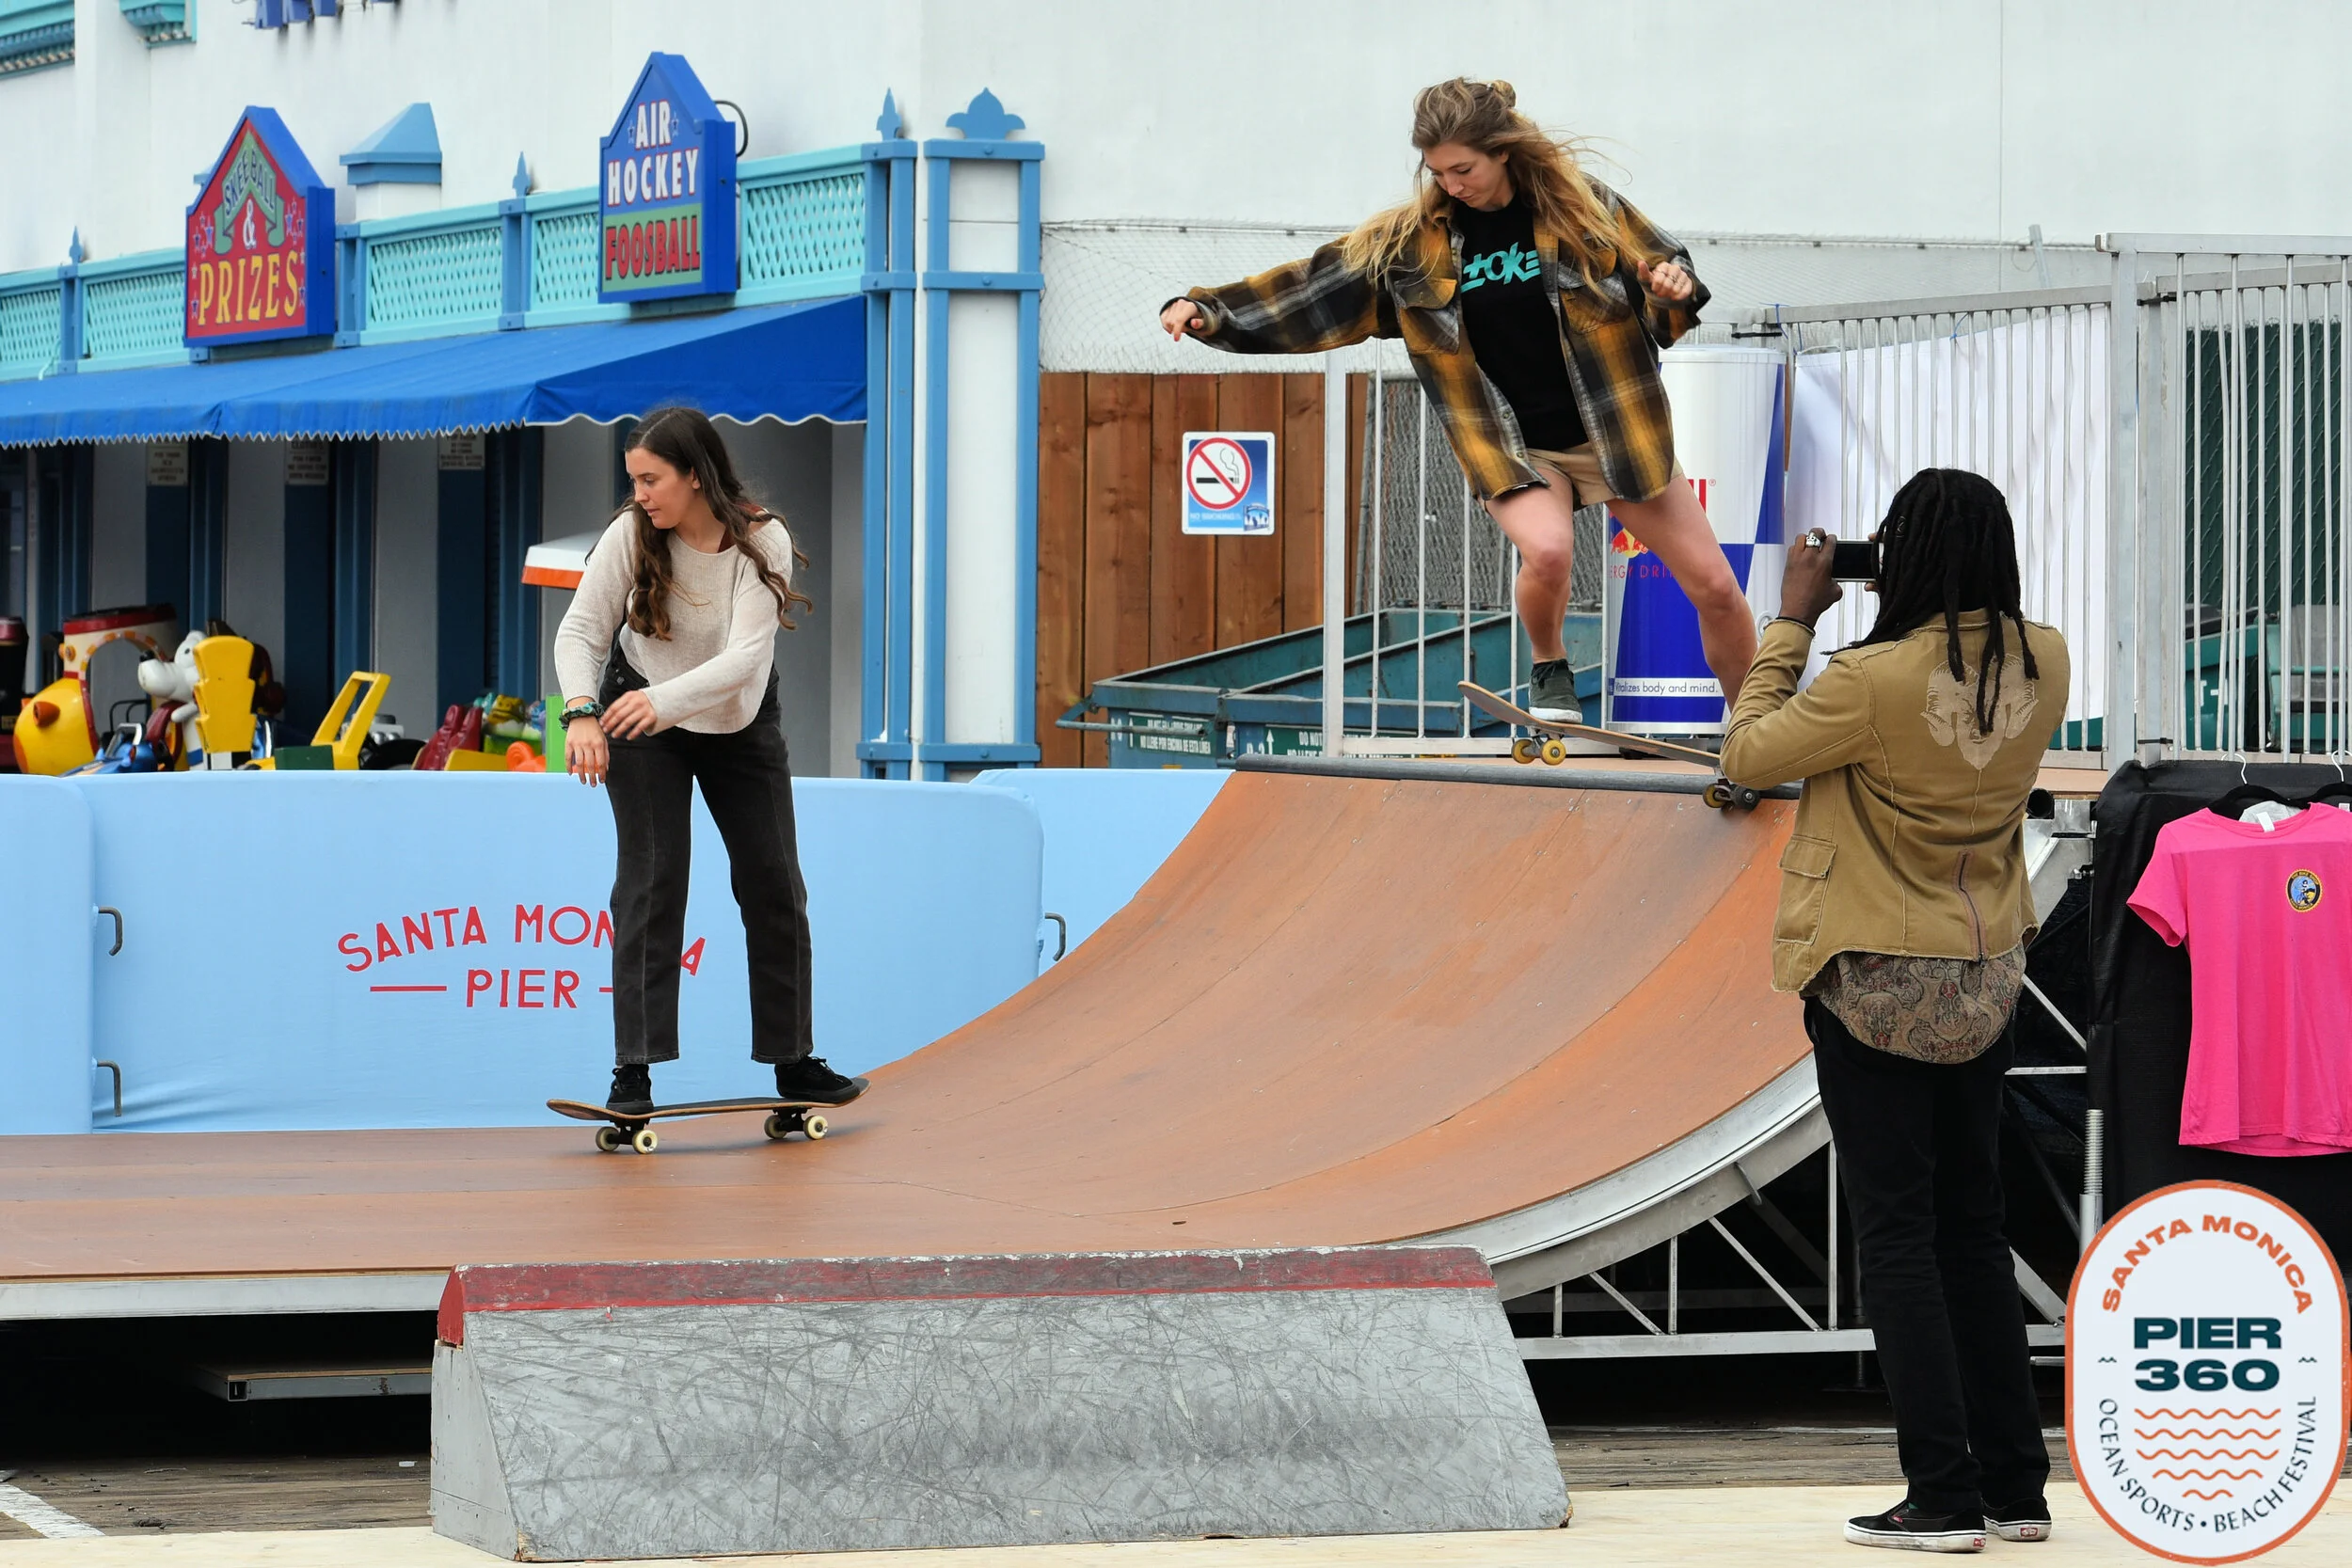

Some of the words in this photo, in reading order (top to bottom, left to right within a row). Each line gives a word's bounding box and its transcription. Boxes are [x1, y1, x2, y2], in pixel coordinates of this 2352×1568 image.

[634, 100, 672, 150] AIR
[225, 149, 250, 216] SKEE
[250, 148, 276, 211] BALL
[607, 147, 699, 207] HOCKEY
[242, 198, 257, 250] &
[605, 215, 700, 280] FOOSBALL
[198, 249, 299, 326] PRIZES
[1640, 564, 1674, 578] DRI
[1642, 681, 1665, 695] body
[1668, 682, 1687, 693] and
[1690, 682, 1718, 693] mind.
[338, 906, 487, 972] SANTA
[515, 904, 706, 976] MONA
[466, 969, 580, 1008] PIER
